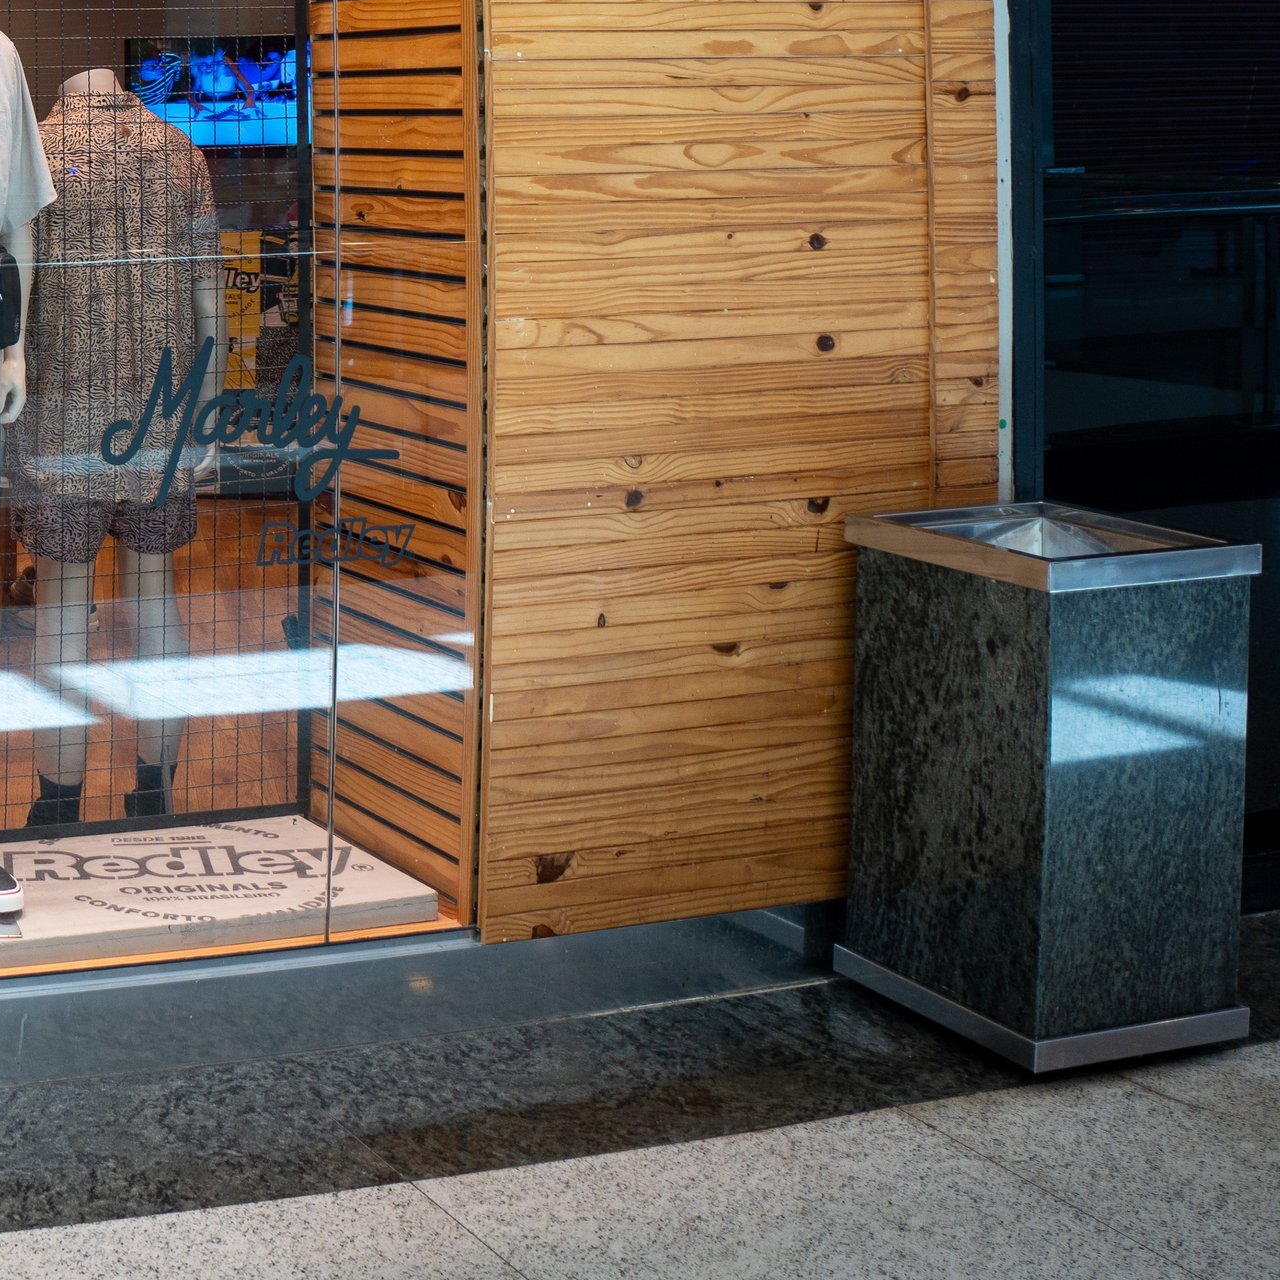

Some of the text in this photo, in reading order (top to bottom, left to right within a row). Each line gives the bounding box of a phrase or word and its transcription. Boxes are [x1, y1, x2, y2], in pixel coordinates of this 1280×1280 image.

[100, 335, 400, 508] Marley
[256, 517, 416, 567] Redley
[3, 845, 352, 881] Redley
[119, 881, 288, 895] ORIGINALS
[74, 894, 217, 922] CONFORTO
